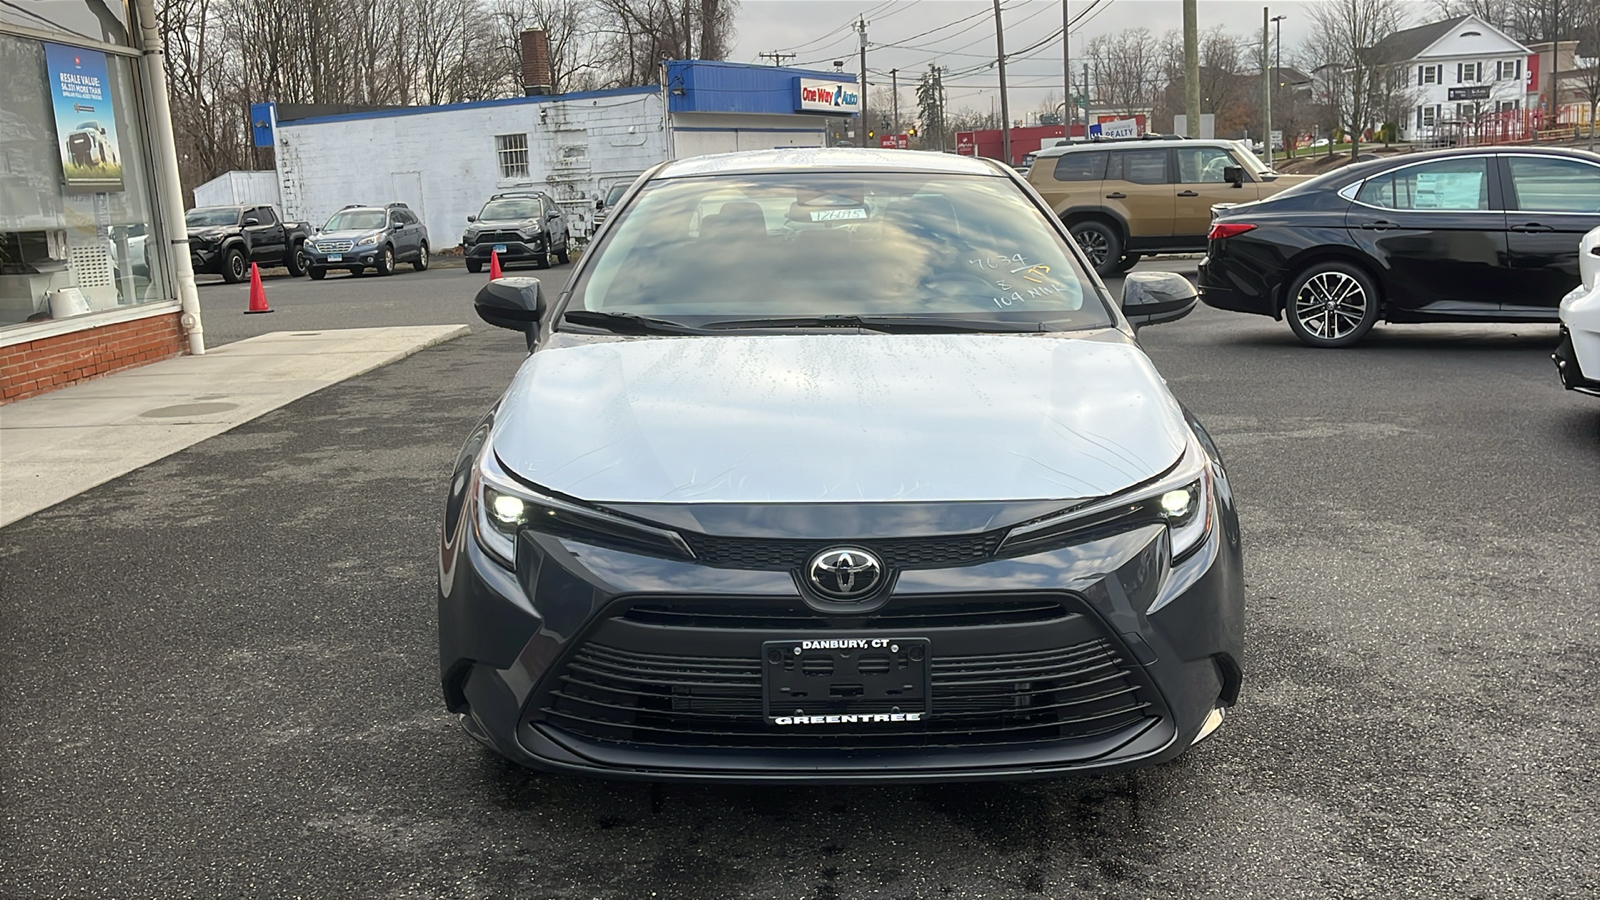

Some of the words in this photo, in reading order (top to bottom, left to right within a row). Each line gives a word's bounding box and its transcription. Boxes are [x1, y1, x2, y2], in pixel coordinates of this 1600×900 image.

[60, 72, 80, 84] RESALE
[81, 75, 101, 86] VALUE:
[76, 85, 88, 93] MORE
[89, 86, 102, 95] THAN
[802, 87, 816, 101] One
[817, 88, 833, 105] Way
[842, 91, 858, 105] Auto
[802, 639, 868, 649] DANBURY,
[871, 639, 889, 648] CT
[775, 713, 921, 725] GREENTREE
